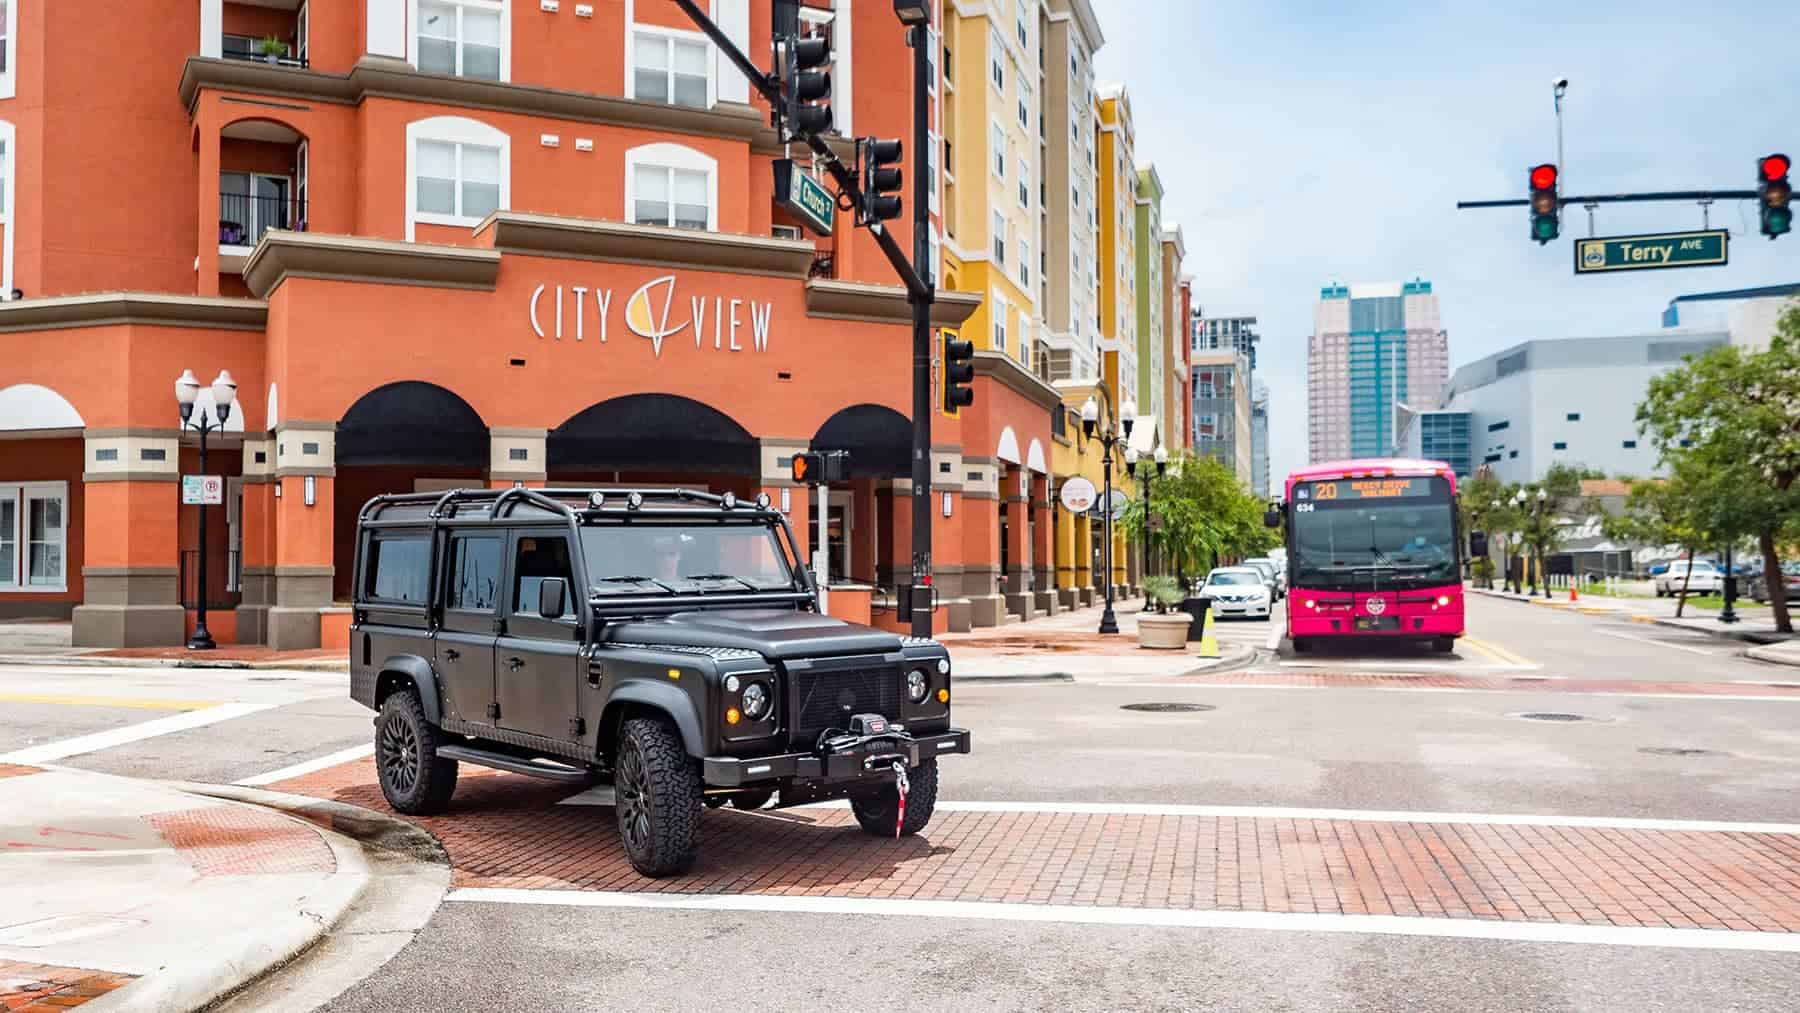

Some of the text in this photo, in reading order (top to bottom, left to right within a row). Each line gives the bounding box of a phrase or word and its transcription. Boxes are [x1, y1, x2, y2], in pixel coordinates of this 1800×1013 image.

[803, 181, 825, 217] Church
[1620, 239, 1703, 264] Terry AVE
[530, 283, 772, 352] CITY VIEW
[1315, 483, 1338, 500] 20
